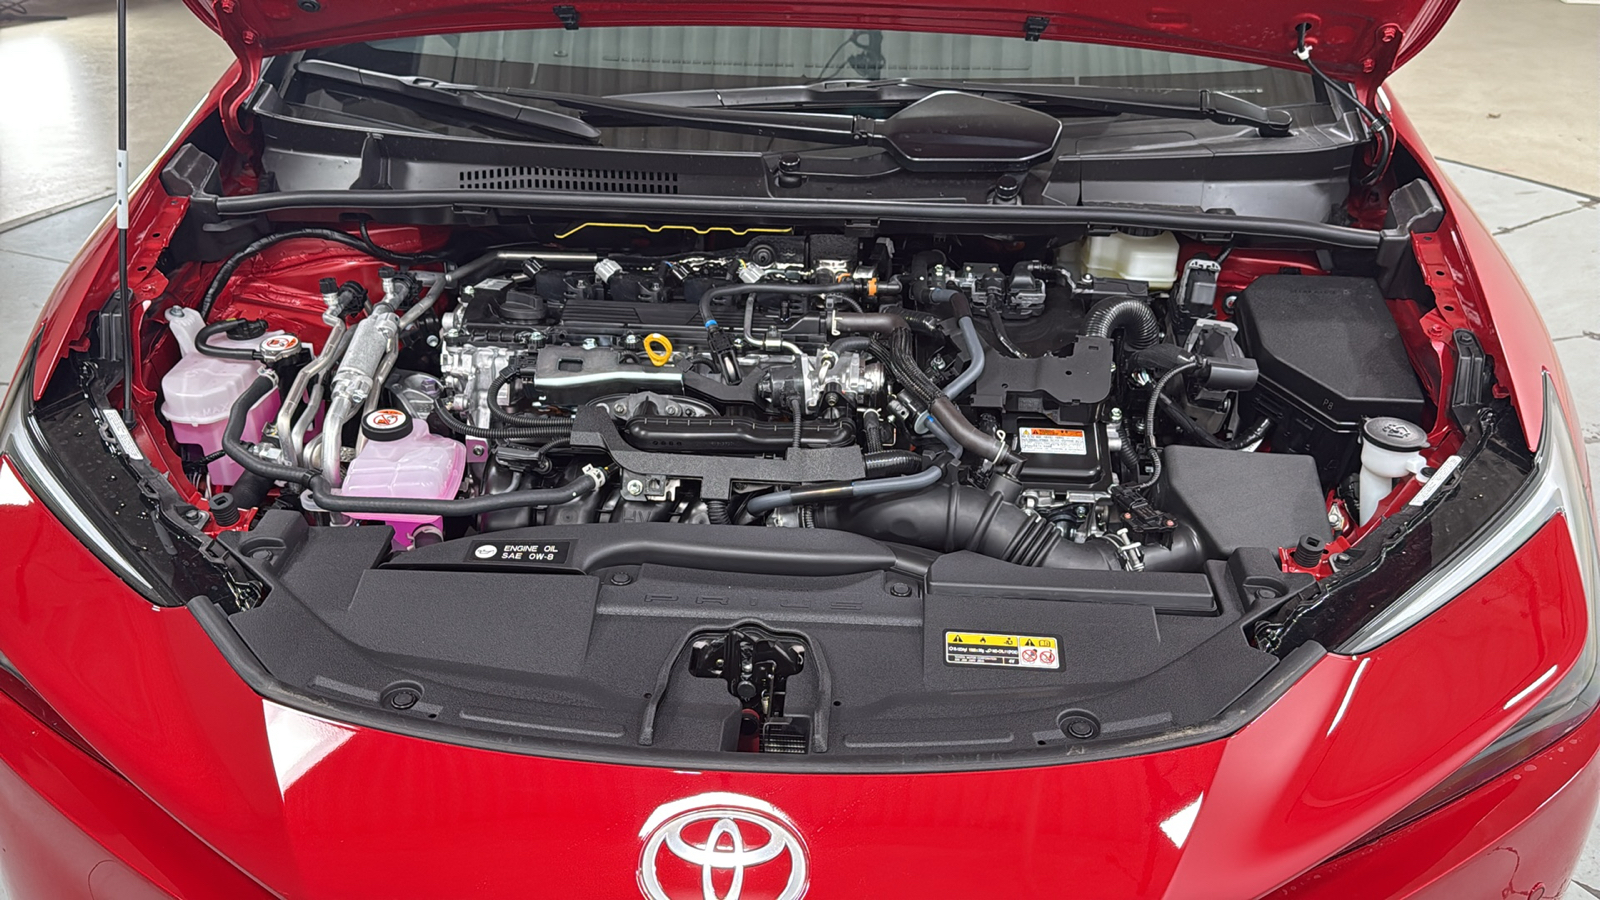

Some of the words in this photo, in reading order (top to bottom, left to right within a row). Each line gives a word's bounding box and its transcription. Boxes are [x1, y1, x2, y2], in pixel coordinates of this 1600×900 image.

[202, 402, 229, 416] MAX
[543, 545, 559, 553] OIL
[501, 552, 523, 560] SAE
[528, 553, 555, 561] 0W-8
[643, 594, 863, 611] PRIUS
